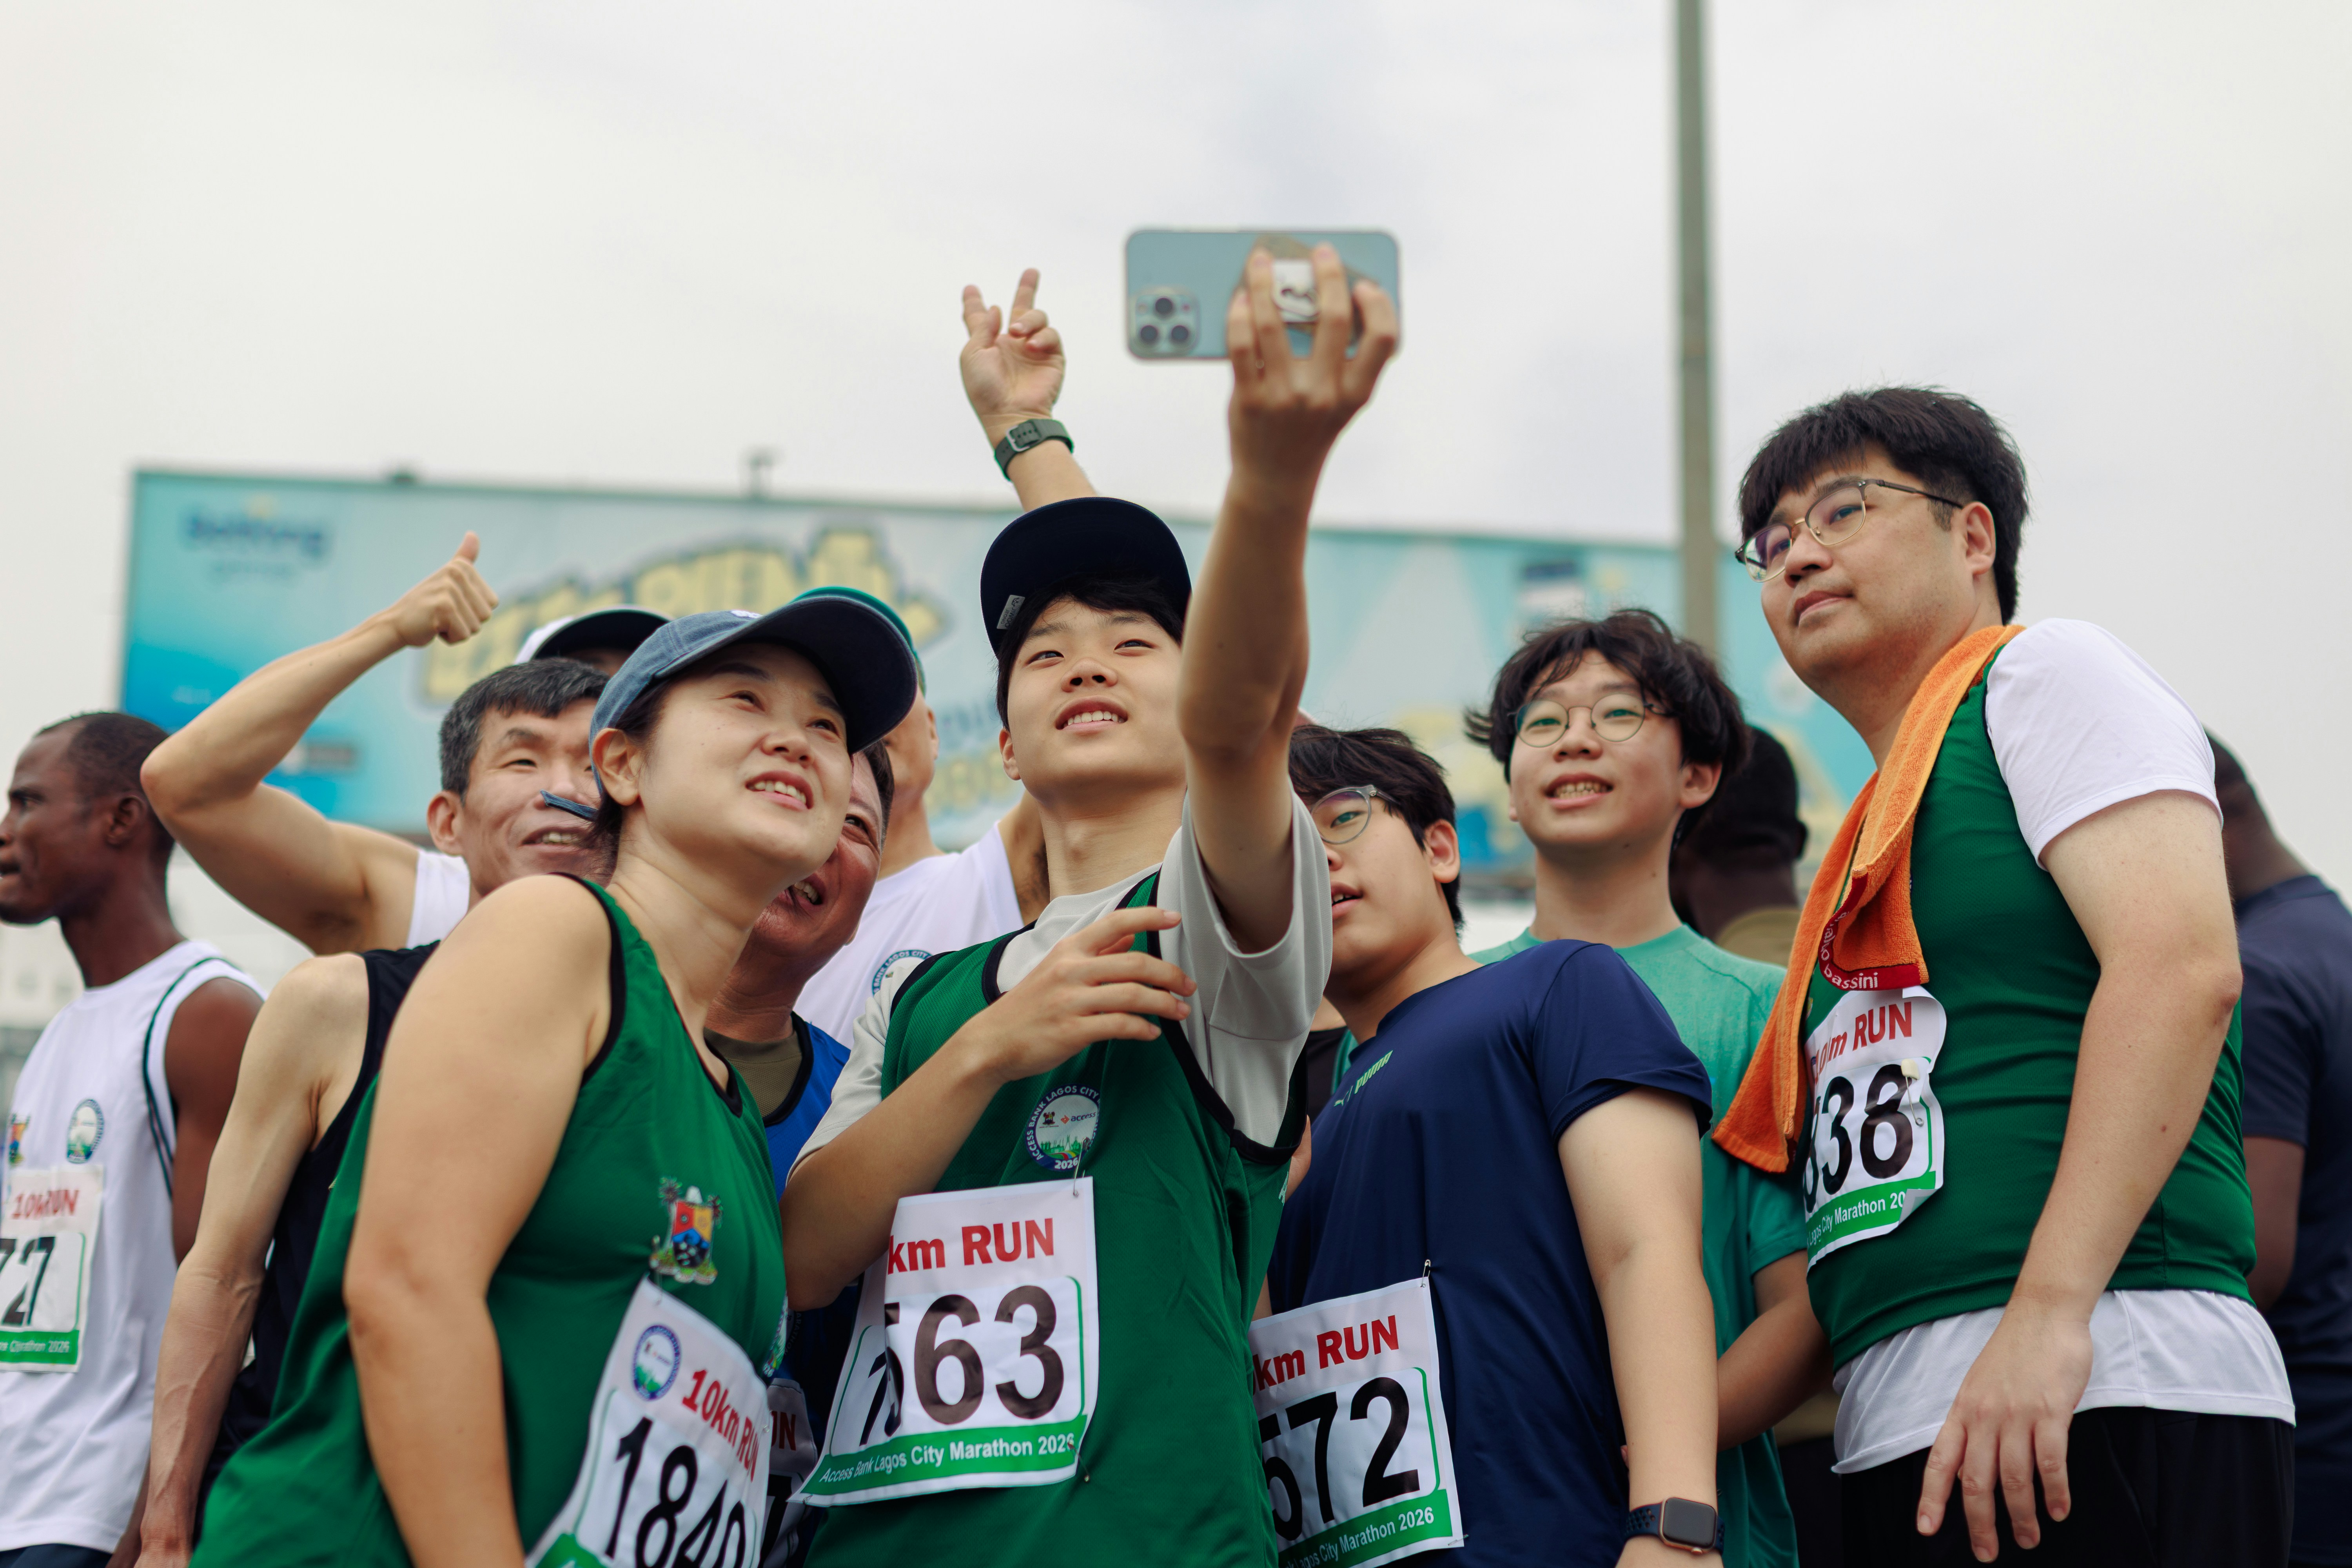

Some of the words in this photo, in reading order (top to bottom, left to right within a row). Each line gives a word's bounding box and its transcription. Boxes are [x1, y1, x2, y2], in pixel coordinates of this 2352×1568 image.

[885, 951, 910, 966] LAGOS
[1824, 964, 1878, 989] bassini
[1852, 1002, 1912, 1051] RUN
[1046, 1085, 1077, 1102] LAGOS
[1080, 1087, 1099, 1098] CITY
[1028, 1101, 1046, 1127] BANK
[1071, 1112, 1096, 1122] access
[1027, 1130, 1044, 1160] ACCESS
[1054, 1157, 1078, 1169] 2026
[1822, 1214, 1833, 1232] City
[1835, 1199, 1886, 1225] Marathon
[961, 1218, 1055, 1266] RUN
[1253, 1348, 1306, 1394] km
[1317, 1315, 1399, 1369] RUN
[682, 1370, 740, 1449] 10km
[737, 1416, 760, 1483] RUN
[819, 1468, 854, 1483] Access
[874, 1453, 907, 1475] Lagos
[911, 1443, 945, 1467] City
[950, 1437, 1033, 1461] Marathon
[1038, 1433, 1074, 1455] 2026
[1319, 1542, 1339, 1561] City
[1339, 1521, 1396, 1554] Marathon
[1398, 1506, 1434, 1532] 2026
